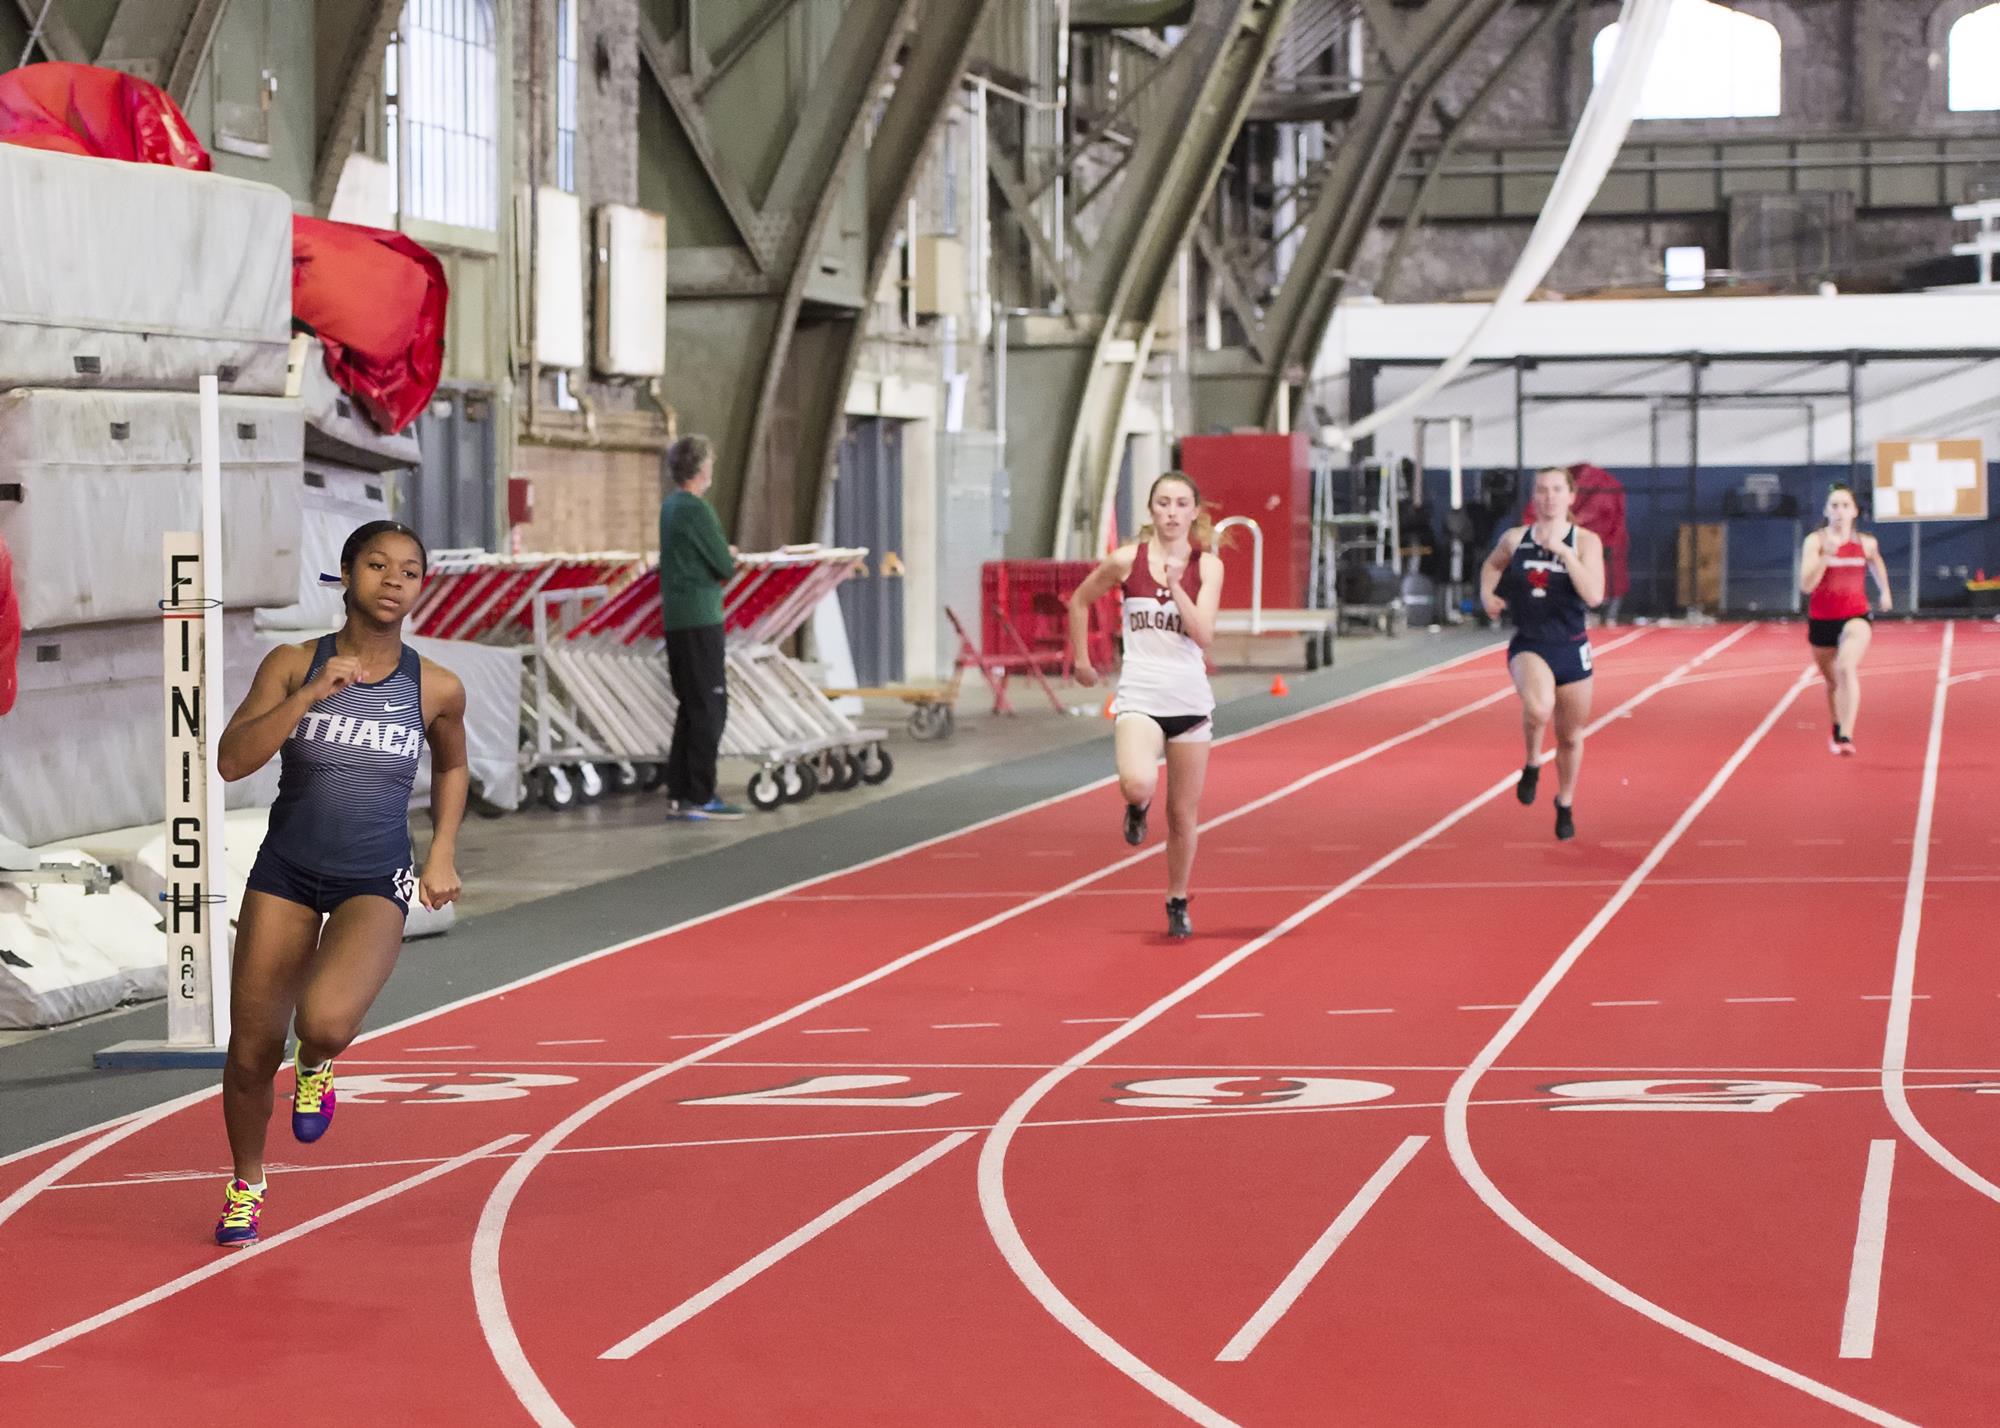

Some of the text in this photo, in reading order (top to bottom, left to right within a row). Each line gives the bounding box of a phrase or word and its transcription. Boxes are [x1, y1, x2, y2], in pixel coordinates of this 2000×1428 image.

[1130, 610, 1189, 637] COLGAT
[171, 555, 201, 934] FINISH
[678, 1074, 962, 1107] 7
